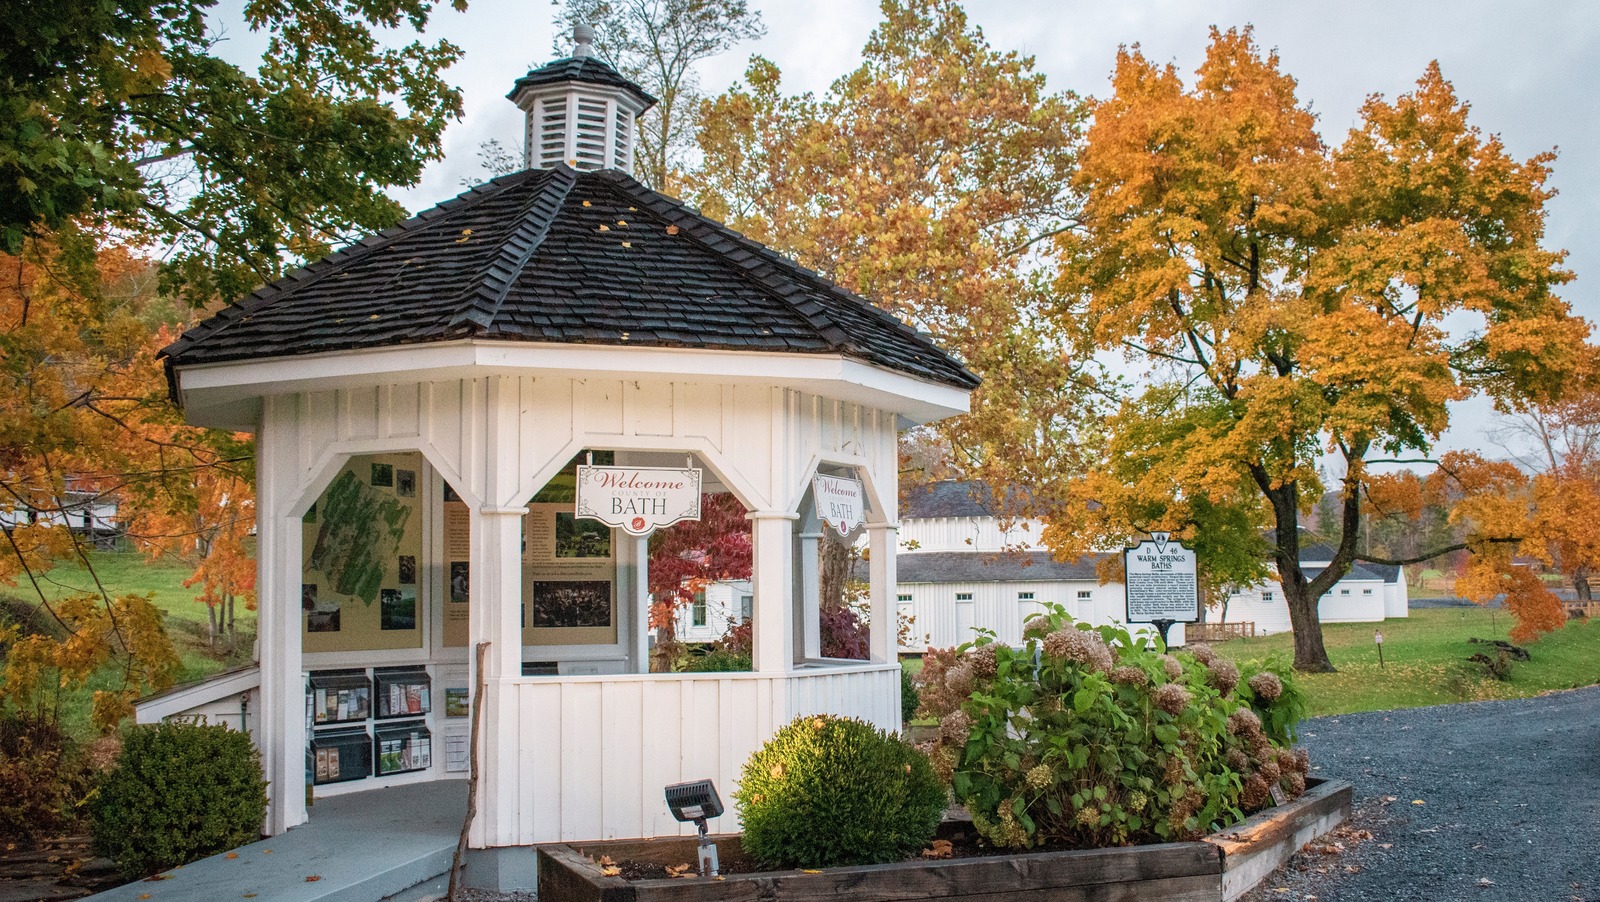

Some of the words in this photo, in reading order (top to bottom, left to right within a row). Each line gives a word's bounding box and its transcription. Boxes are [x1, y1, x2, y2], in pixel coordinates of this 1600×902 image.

[594, 472, 685, 490] Welcome
[820, 479, 857, 497] Welcome
[612, 497, 667, 515] BATH
[830, 502, 853, 519] BATH
